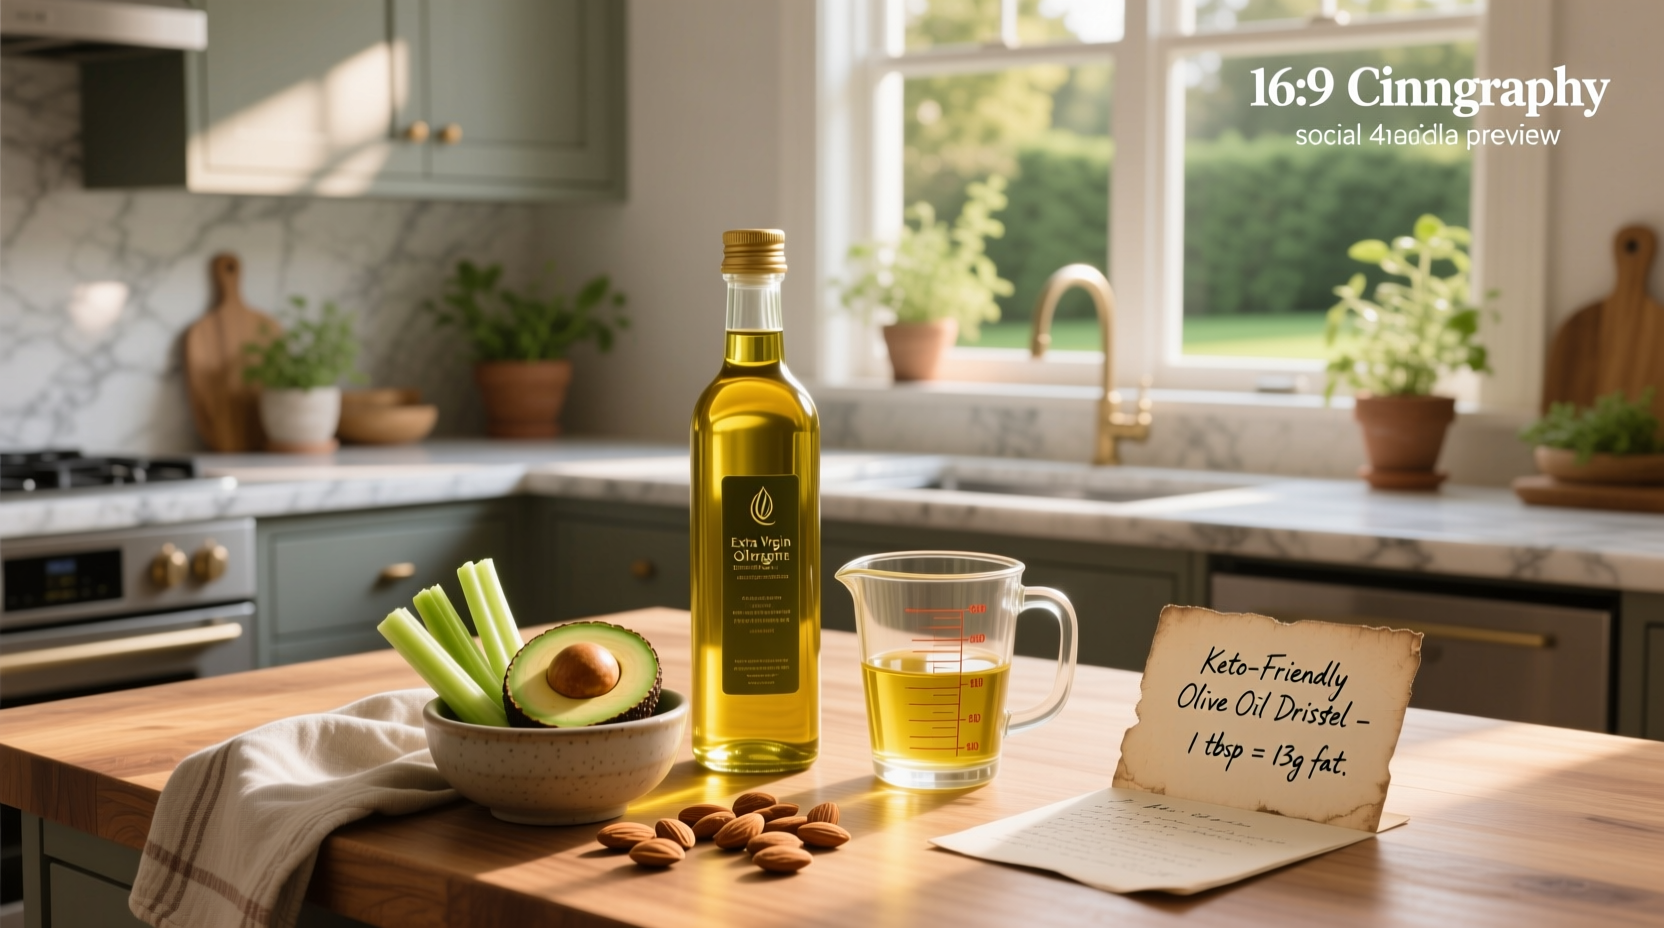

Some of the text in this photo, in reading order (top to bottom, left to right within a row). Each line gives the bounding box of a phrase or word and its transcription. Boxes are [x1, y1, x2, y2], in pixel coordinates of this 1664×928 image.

[1200, 646, 1348, 702] Keto-Friendly
[1177, 682, 1228, 712] Olive
[1235, 691, 1272, 718] Oil
[1204, 731, 1244, 771] tbsp
[1272, 744, 1305, 782] 13g
[1307, 744, 1347, 779] fat.
